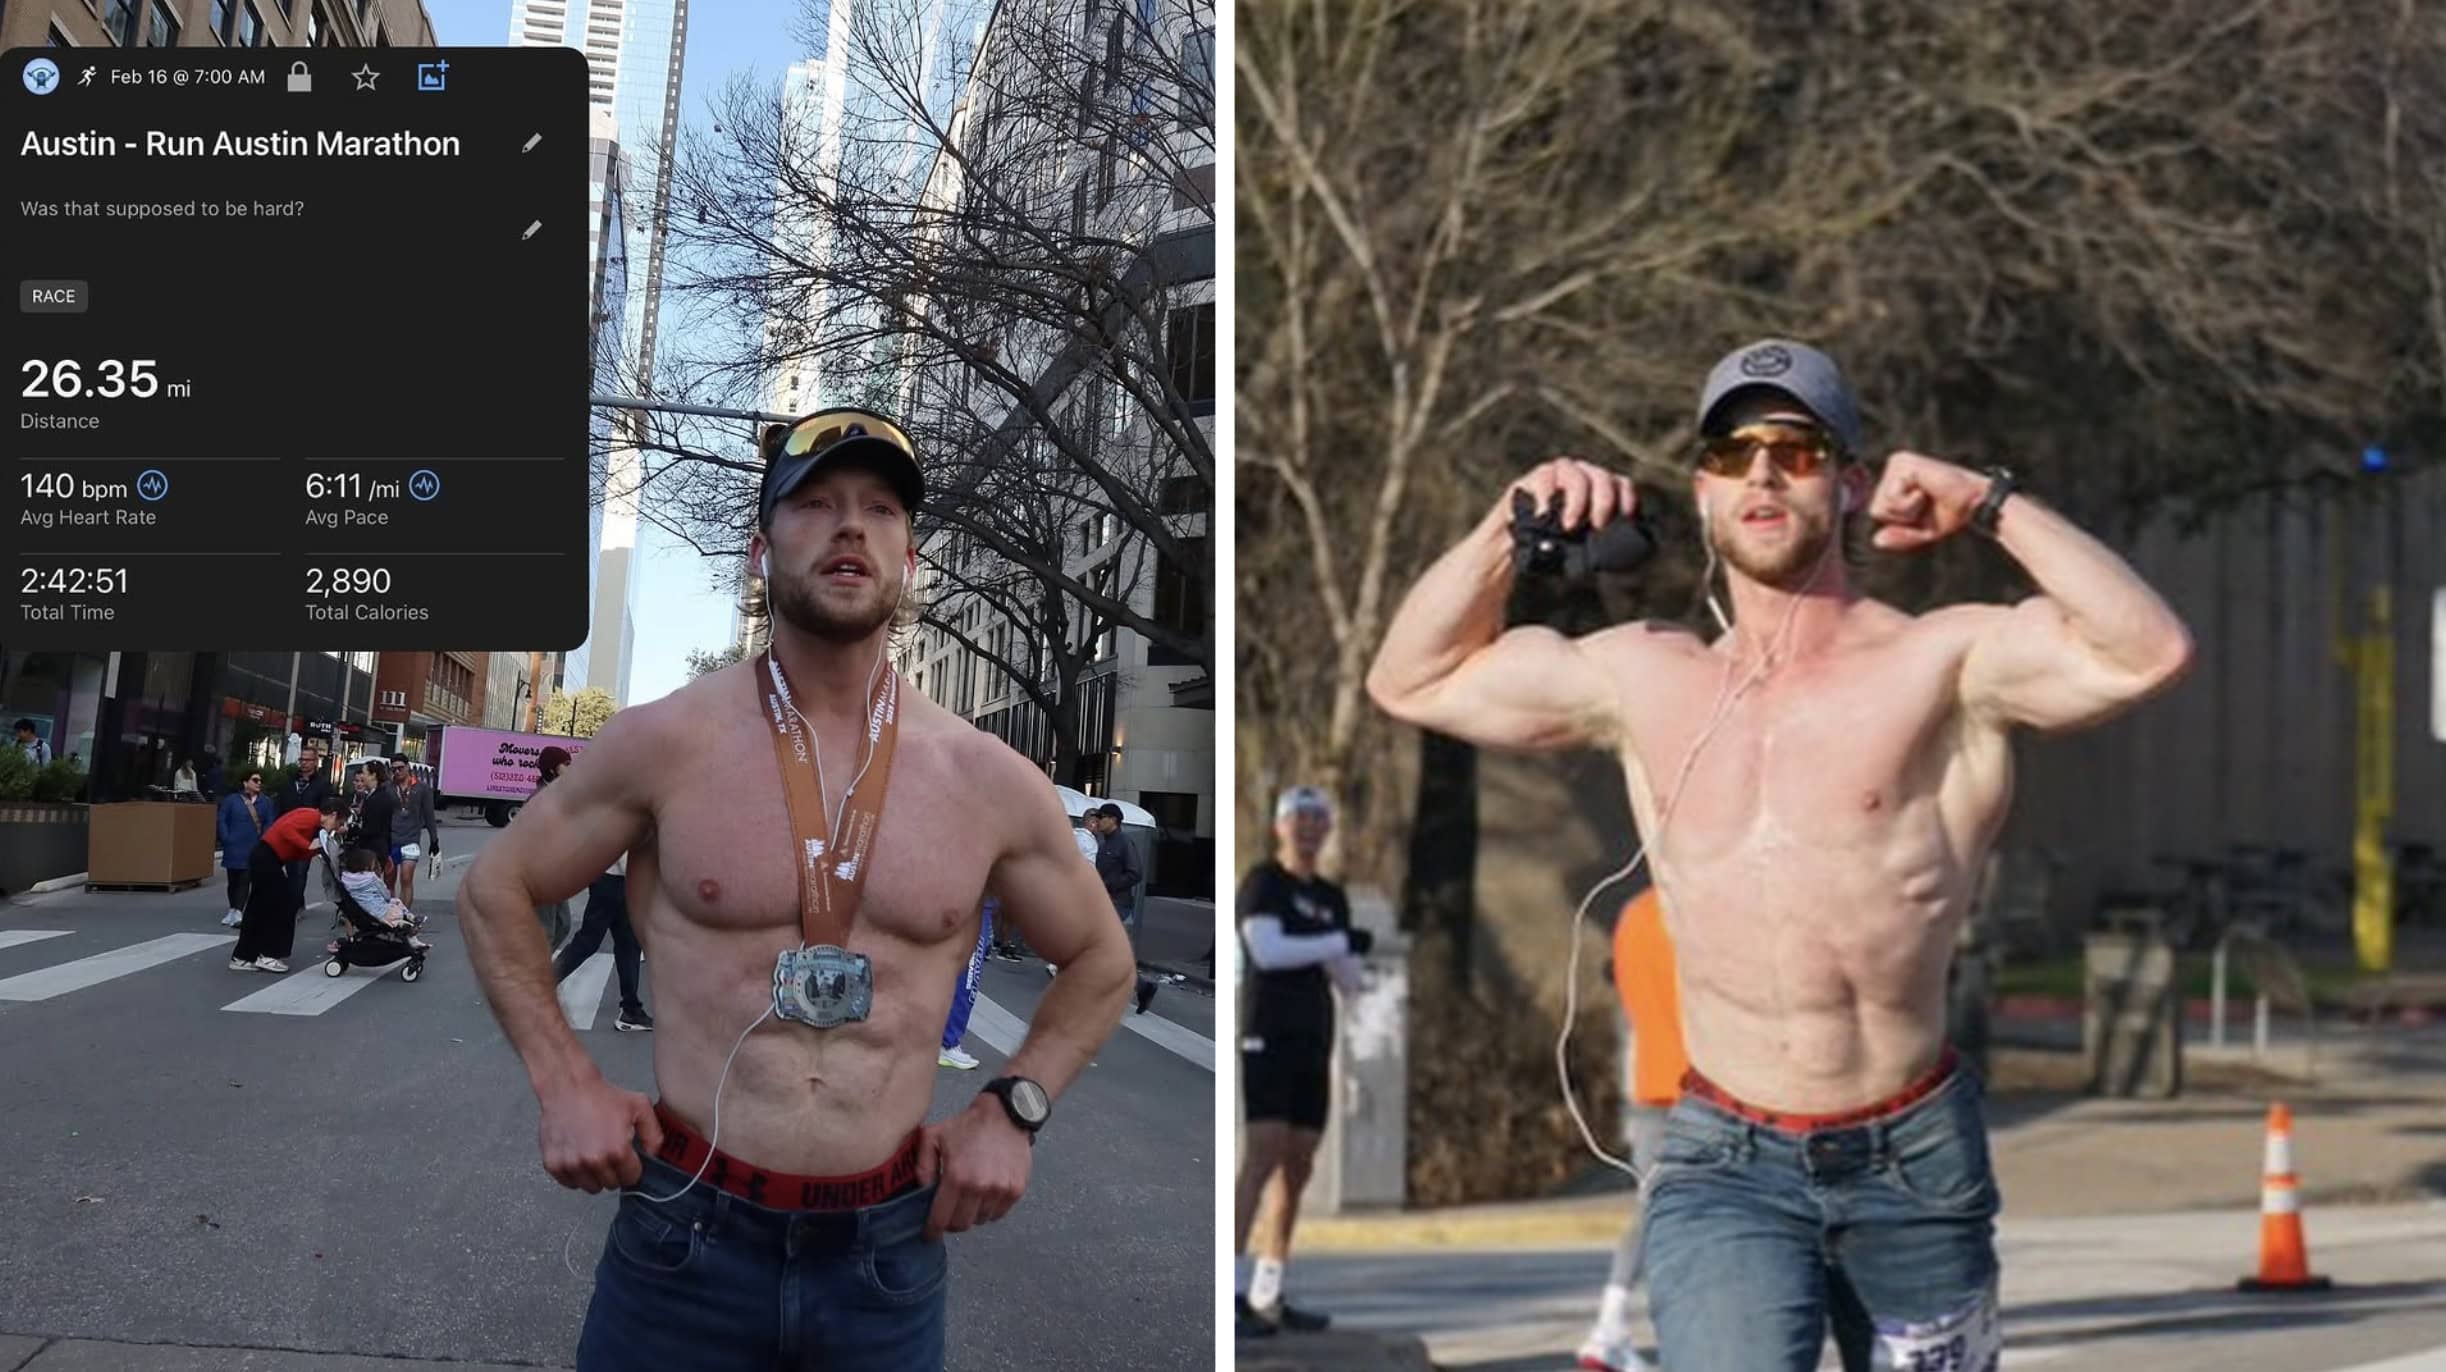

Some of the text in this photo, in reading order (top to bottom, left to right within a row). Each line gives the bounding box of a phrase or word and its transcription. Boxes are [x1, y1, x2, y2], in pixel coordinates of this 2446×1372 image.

[498, 742, 540, 757] Movers
[492, 755, 514, 767] who
[801, 1176, 885, 1209] UNDER
